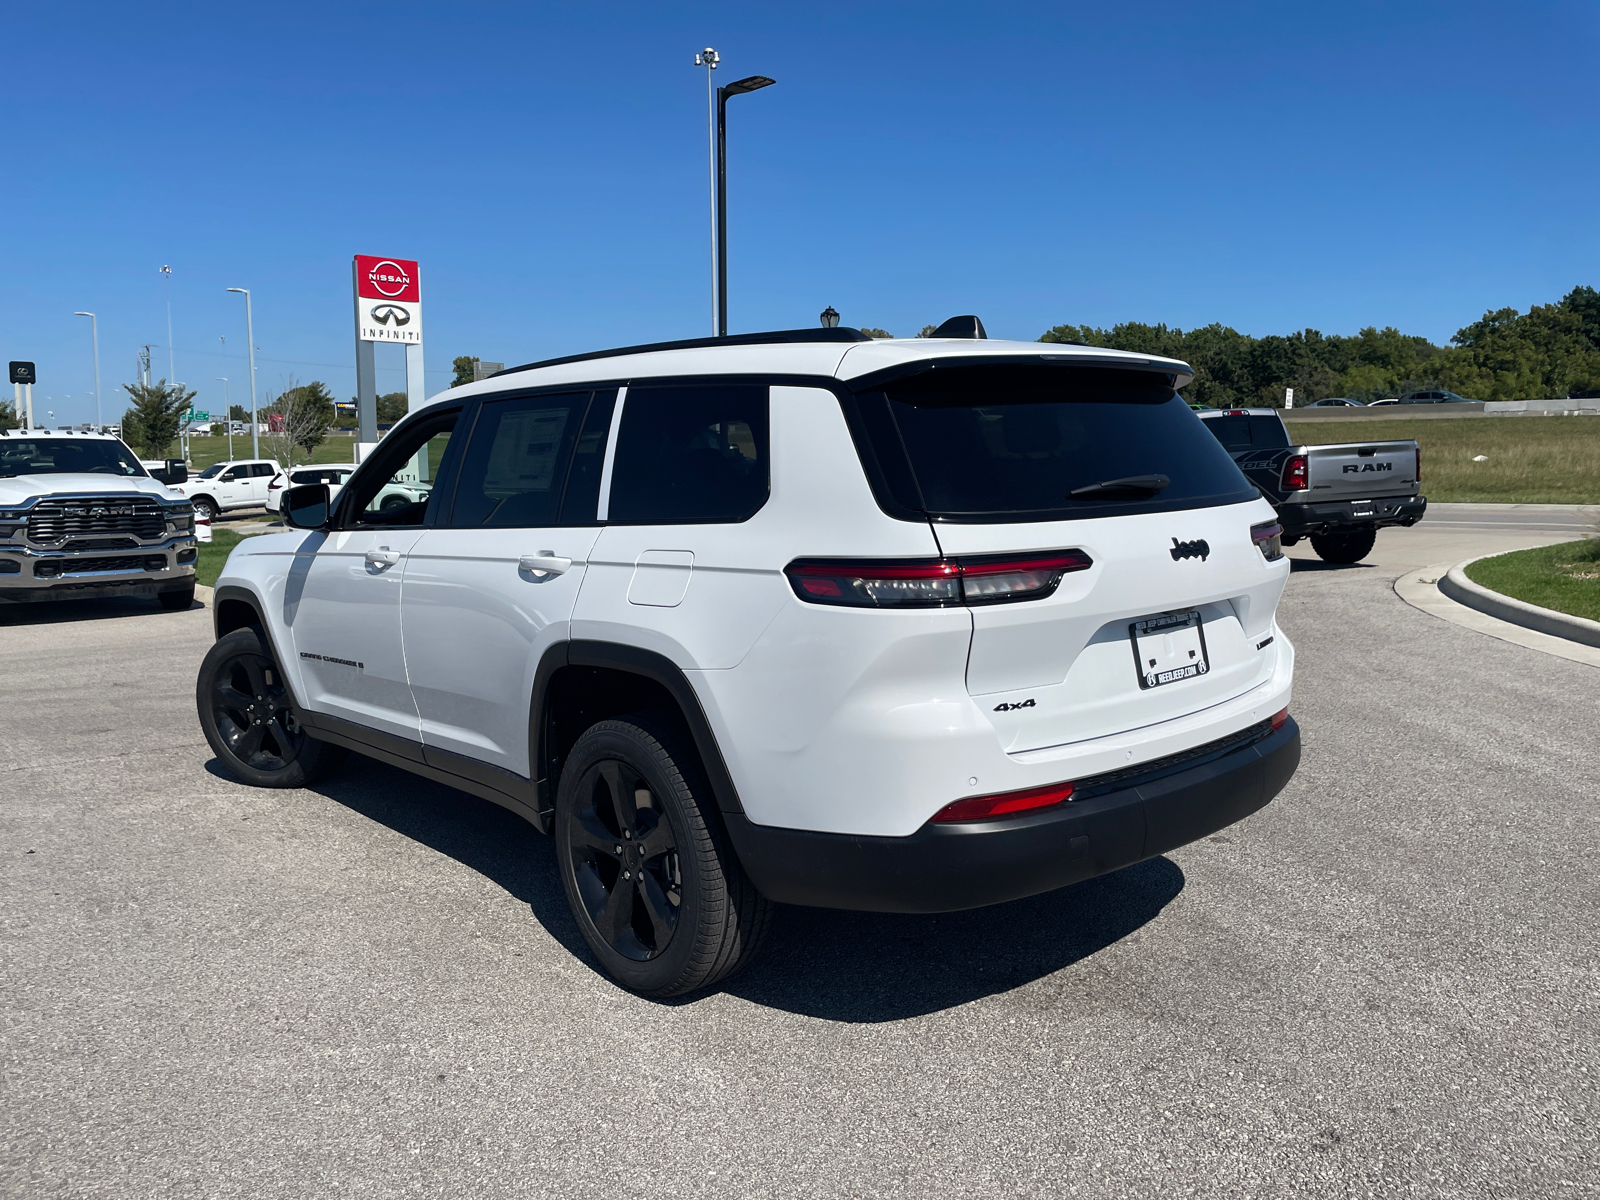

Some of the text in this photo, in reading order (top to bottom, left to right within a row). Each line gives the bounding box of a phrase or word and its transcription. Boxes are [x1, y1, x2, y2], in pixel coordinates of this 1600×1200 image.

[368, 273, 410, 284] NISSAN
[363, 328, 419, 340] INFINITI
[1342, 462, 1392, 474] RAM
[64, 506, 133, 517] RAM
[1158, 665, 1197, 684] REEDJEEP.COM
[992, 698, 1037, 712] 4x4
